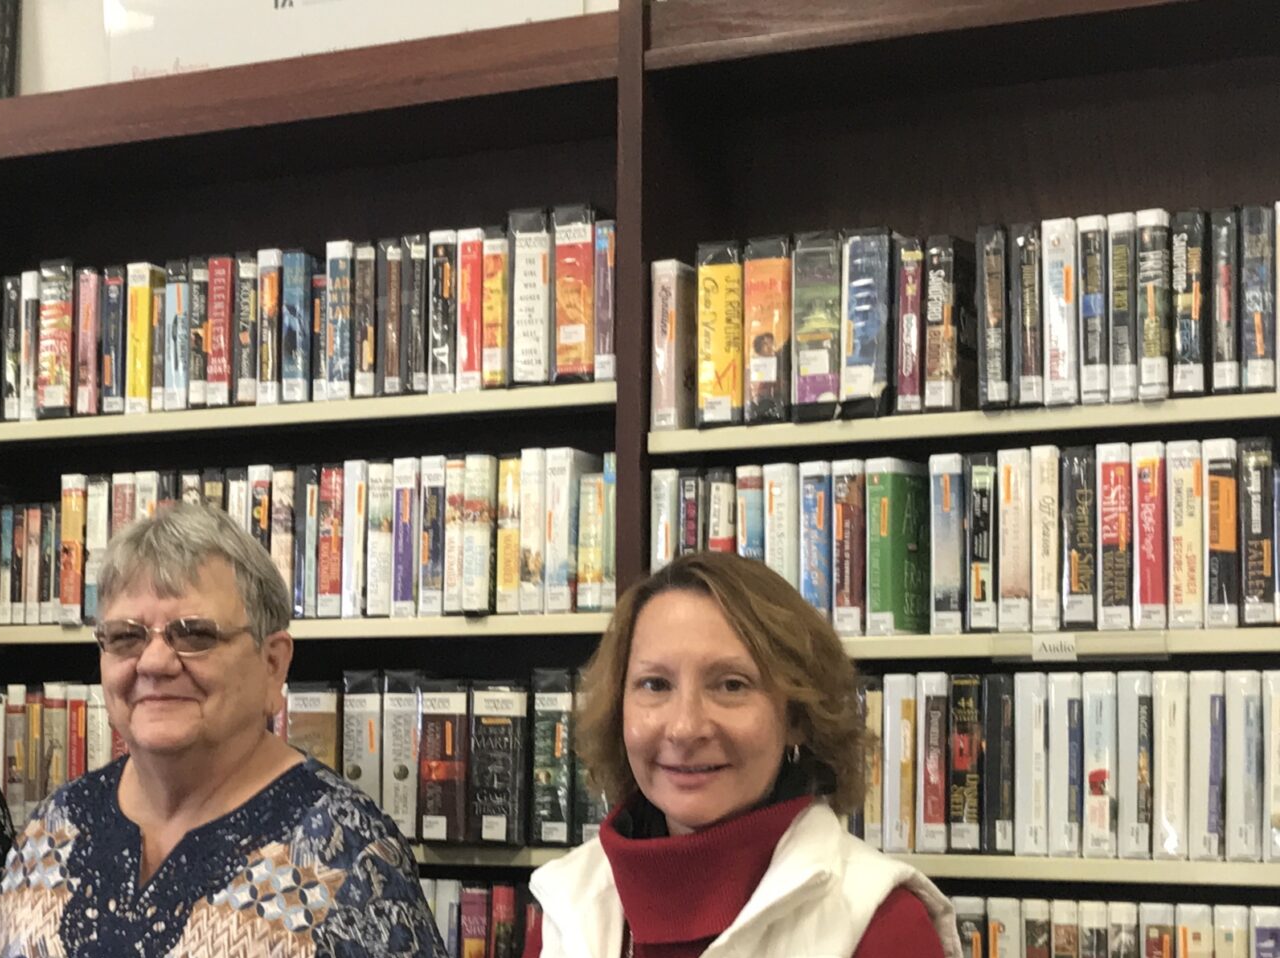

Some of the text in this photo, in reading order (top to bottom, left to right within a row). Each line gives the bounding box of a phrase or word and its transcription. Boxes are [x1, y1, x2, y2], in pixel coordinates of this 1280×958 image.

[1173, 233, 1187, 289] SANDFORD
[213, 268, 226, 351] RELENTLESS
[927, 269, 945, 321] SANDFORD
[1041, 517, 1055, 558] Season
[1102, 485, 1128, 540] Silva
[1075, 488, 1093, 593] Daniel Silva
[1248, 540, 1265, 599] FALLEN
[1039, 640, 1075, 653] Audio
